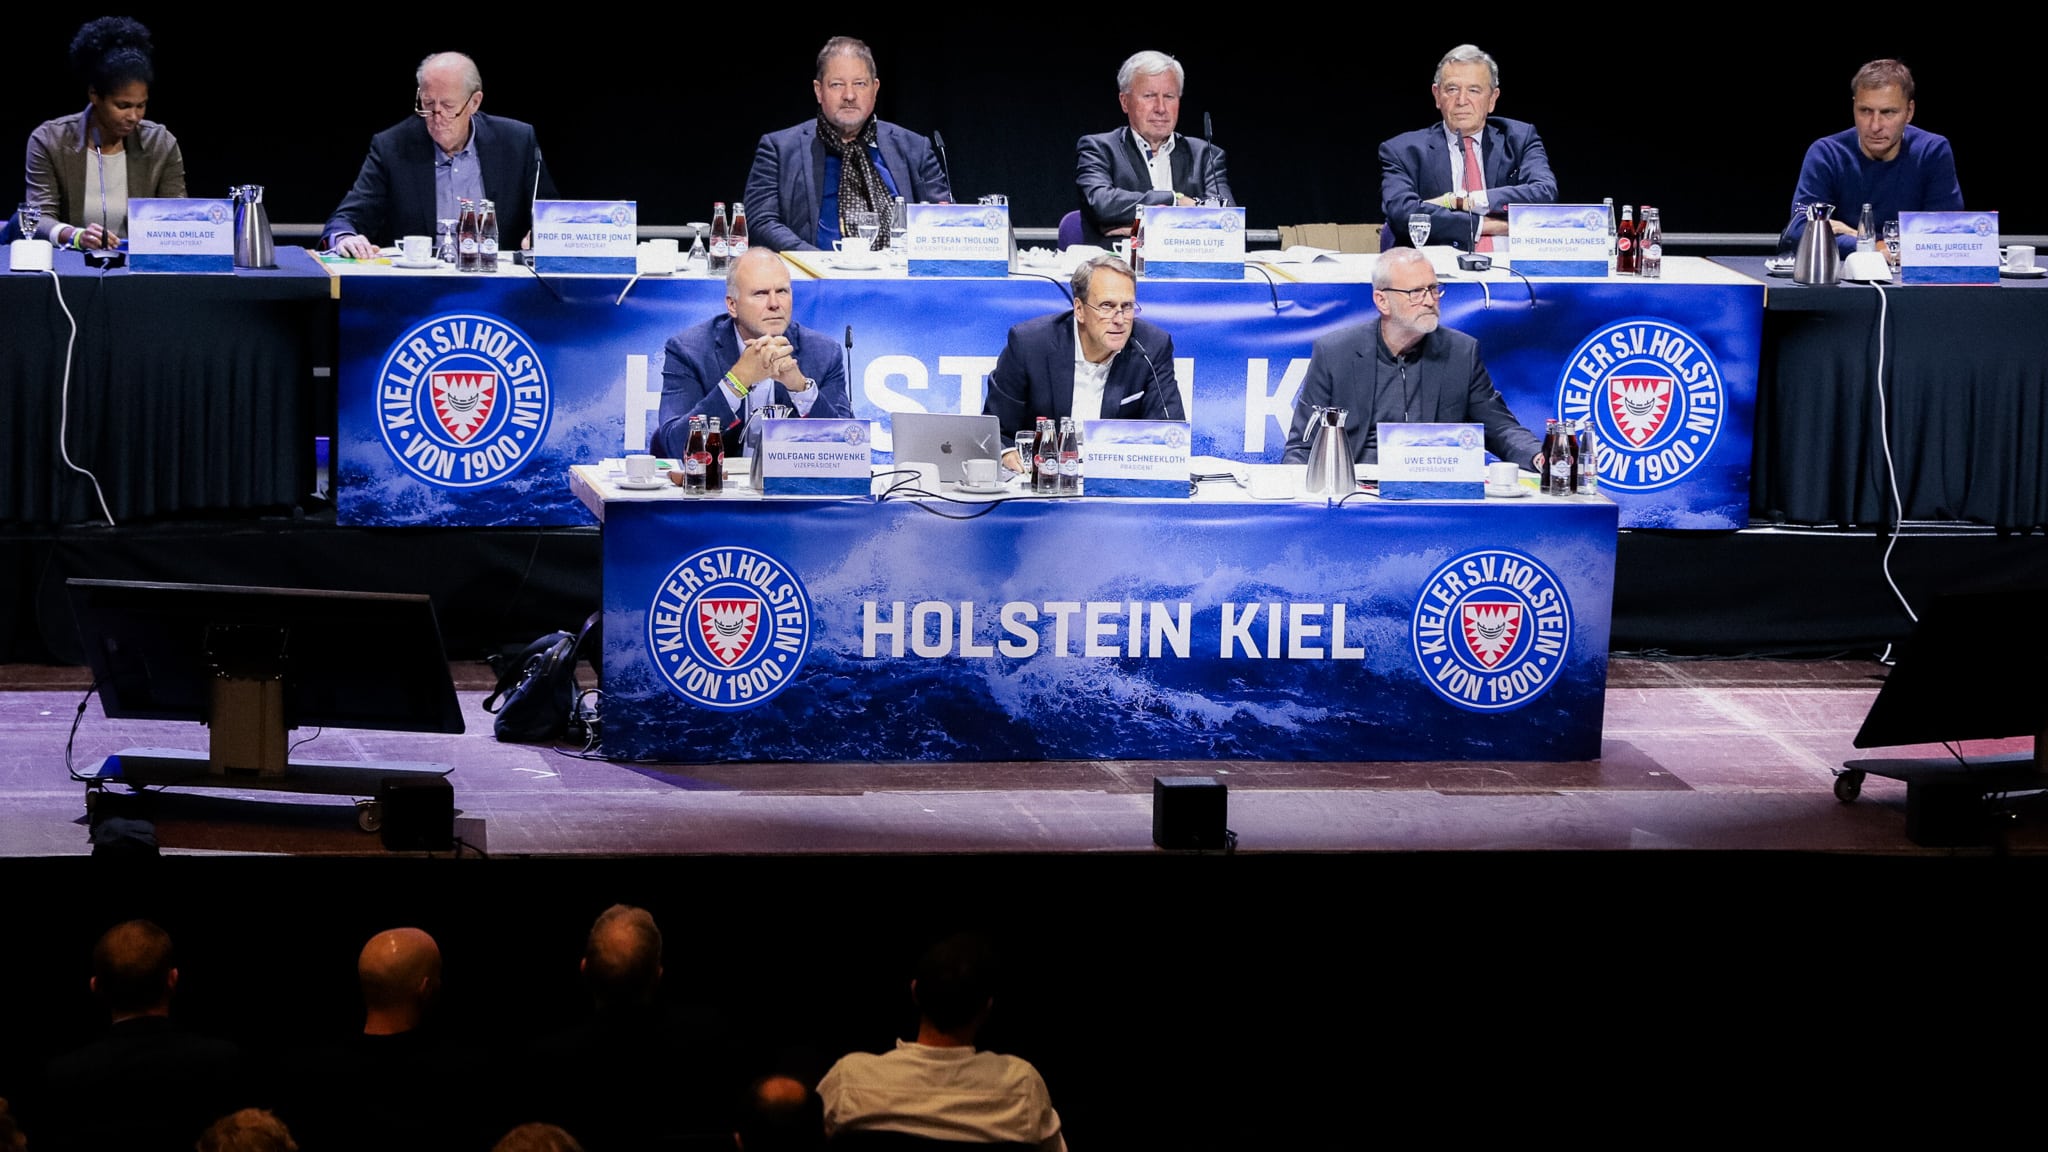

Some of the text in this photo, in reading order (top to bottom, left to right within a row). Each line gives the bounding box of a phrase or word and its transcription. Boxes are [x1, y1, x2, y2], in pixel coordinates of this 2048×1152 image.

[146, 231, 216, 239] NAVINA OMILADE
[609, 233, 632, 242] JONAT
[931, 236, 961, 244] STEFAN
[963, 236, 999, 244] THOLUND
[1163, 238, 1201, 246] GERHARD
[1525, 237, 1563, 245] HERMANN
[1565, 237, 1606, 245] LANGNESS
[1915, 243, 1983, 252] DANIEL JURGELEIT
[384, 337, 437, 430] KIELER
[430, 320, 470, 354] S.V.
[470, 322, 542, 430] HOLSTEIN
[1565, 327, 1717, 435] KIELER S.V. HOLSTEIN
[403, 432, 521, 480] VON 1900
[768, 452, 866, 460] WOLFGANG SCHWENKE
[1088, 453, 1186, 463] STEFFEN SCHNEEKLOTH
[1634, 439, 1695, 483] 1900
[655, 552, 803, 654] KIELER S.V. HOLSTEIN
[1419, 556, 1564, 657] KIELER S.V. HOLSTEIN
[861, 600, 1366, 661] HOLSTEIN KIEL
[673, 655, 783, 701] VON 1900
[1436, 657, 1544, 702] VON 1900
